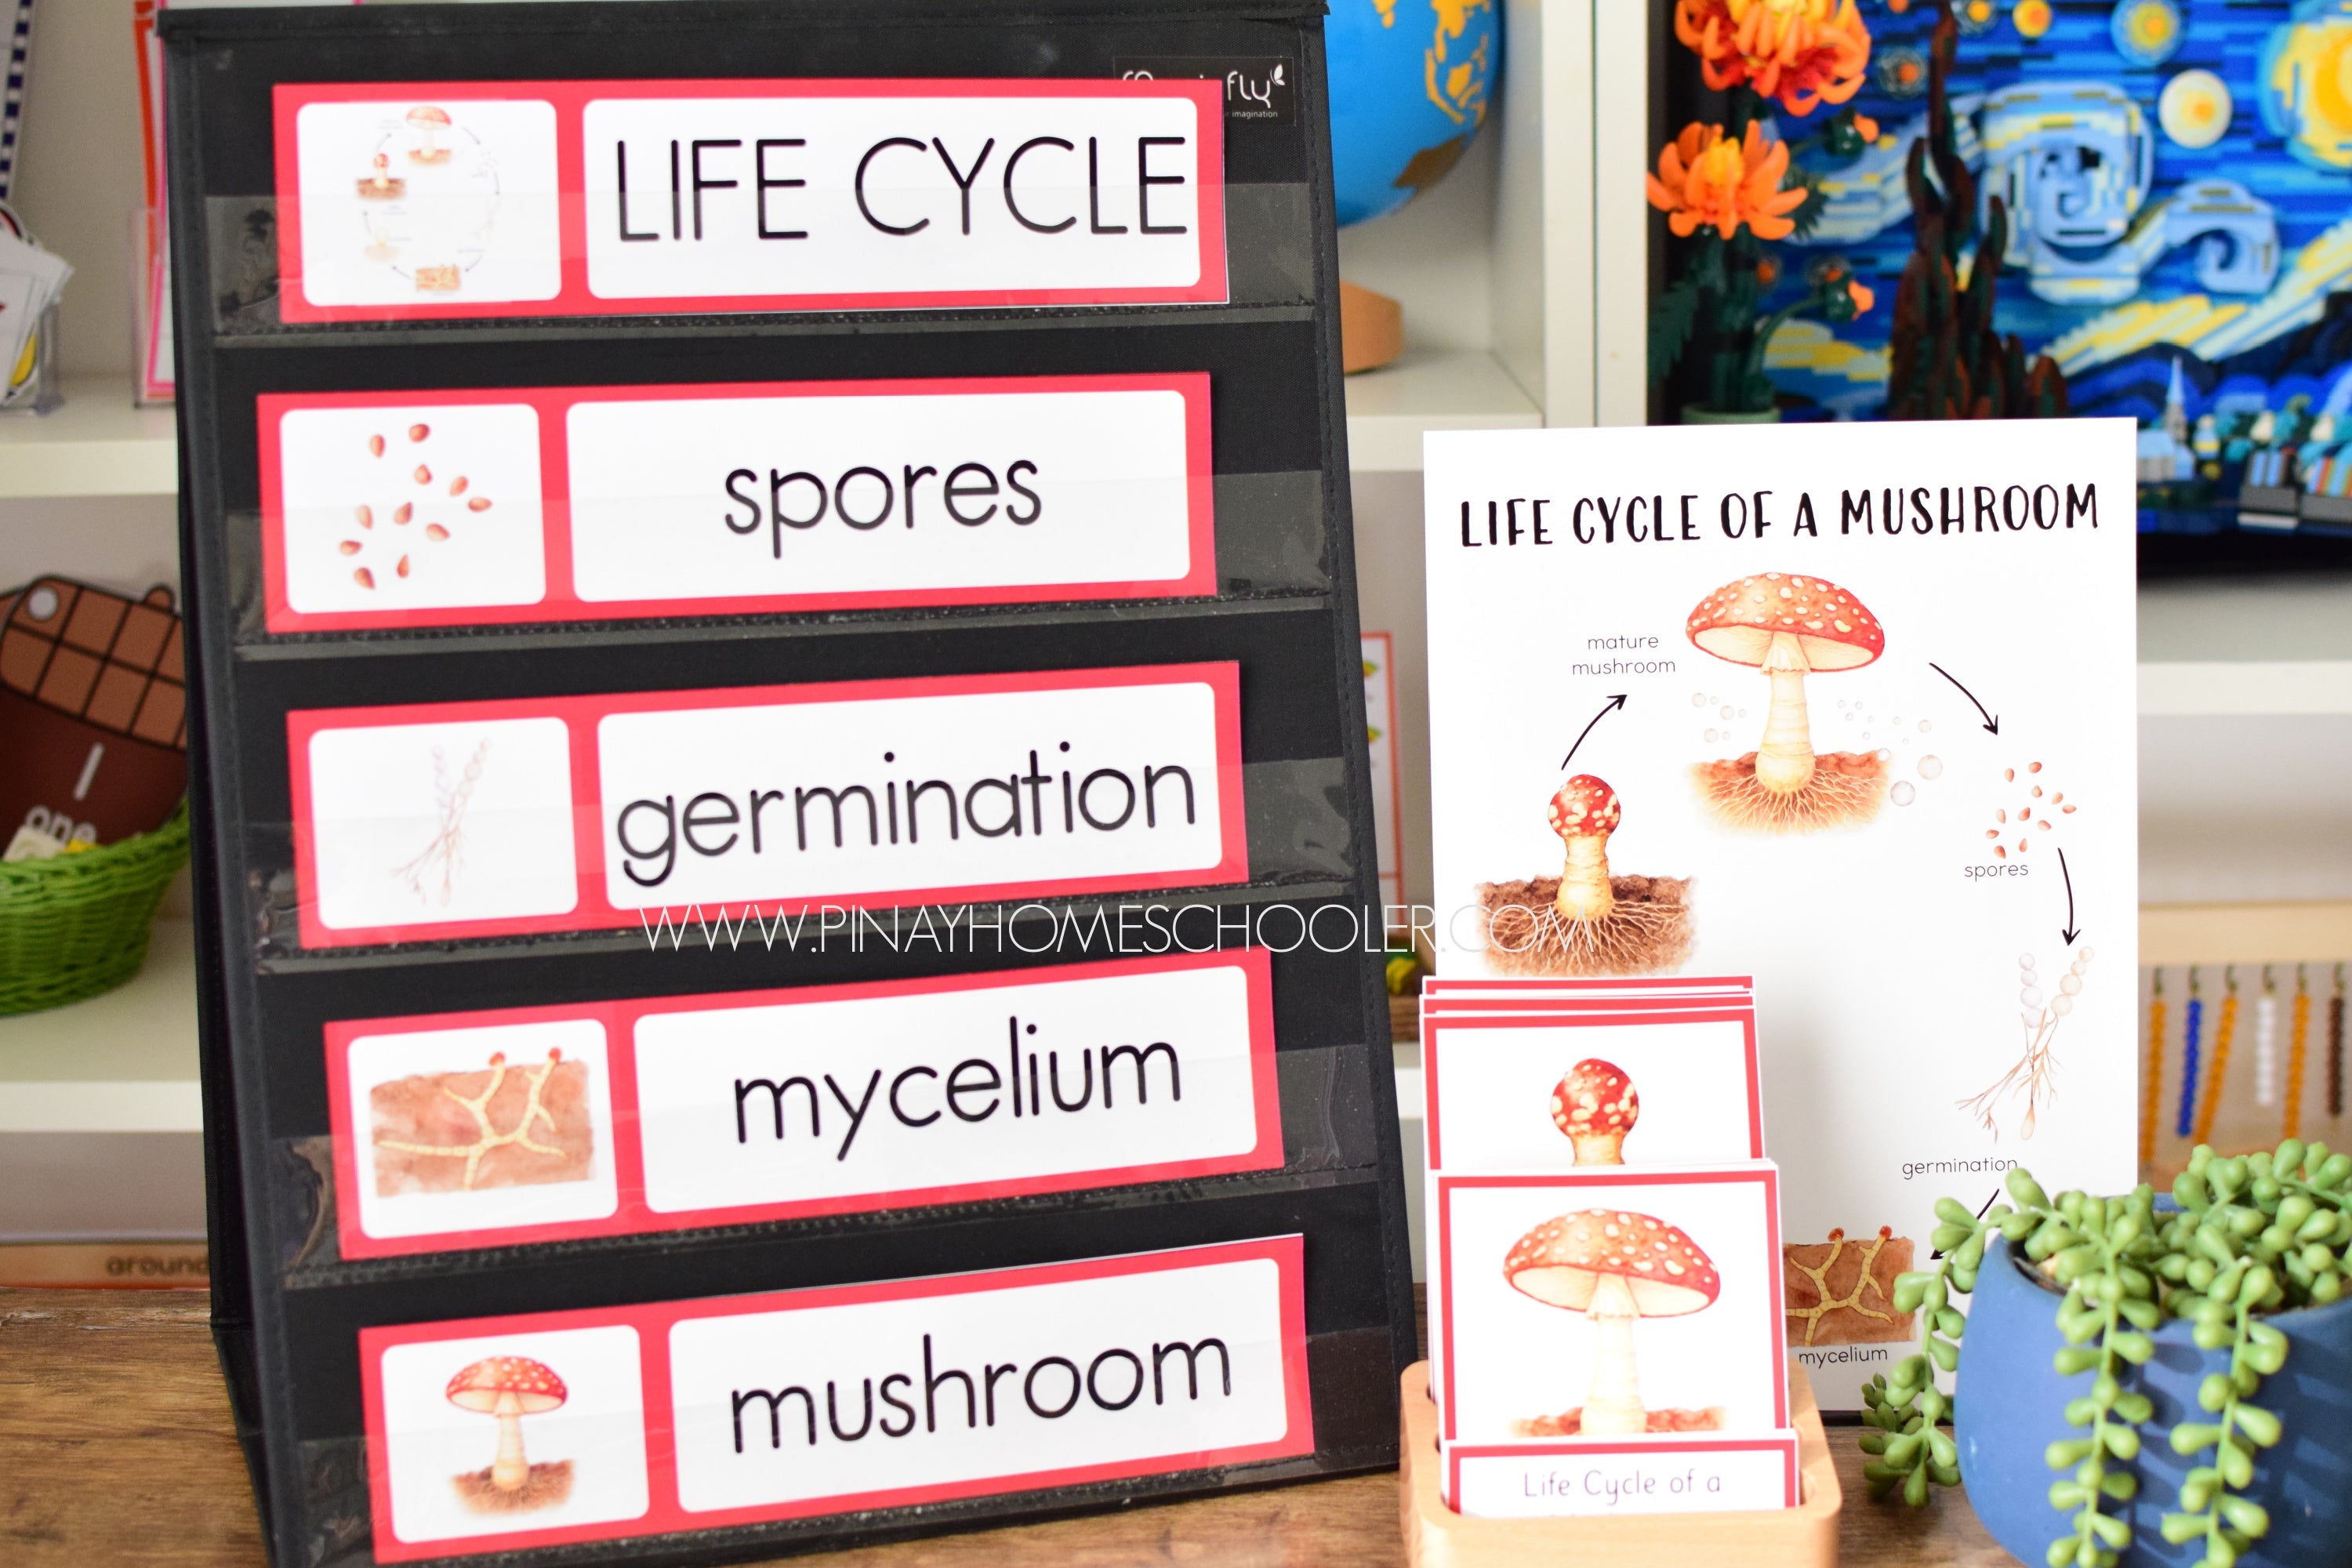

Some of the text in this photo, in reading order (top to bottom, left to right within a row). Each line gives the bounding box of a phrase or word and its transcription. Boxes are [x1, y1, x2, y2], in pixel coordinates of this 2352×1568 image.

[616, 136, 1188, 241] LIFE CYCLE
[724, 459, 1042, 560] spores
[1461, 483, 2099, 547] LIFE CYCLE OF A MUSHROOM
[1572, 657, 1676, 676] mushroom
[1587, 633, 1660, 650] mature
[617, 740, 1196, 887] germination
[1964, 863, 2029, 882] spores
[734, 1015, 1181, 1162] mycelium
[1902, 1156, 2018, 1181] germination
[1798, 1345, 1889, 1370] mycelium
[731, 1333, 1231, 1454] mushroom
[1523, 1468, 1721, 1506] Life Cycle of a
